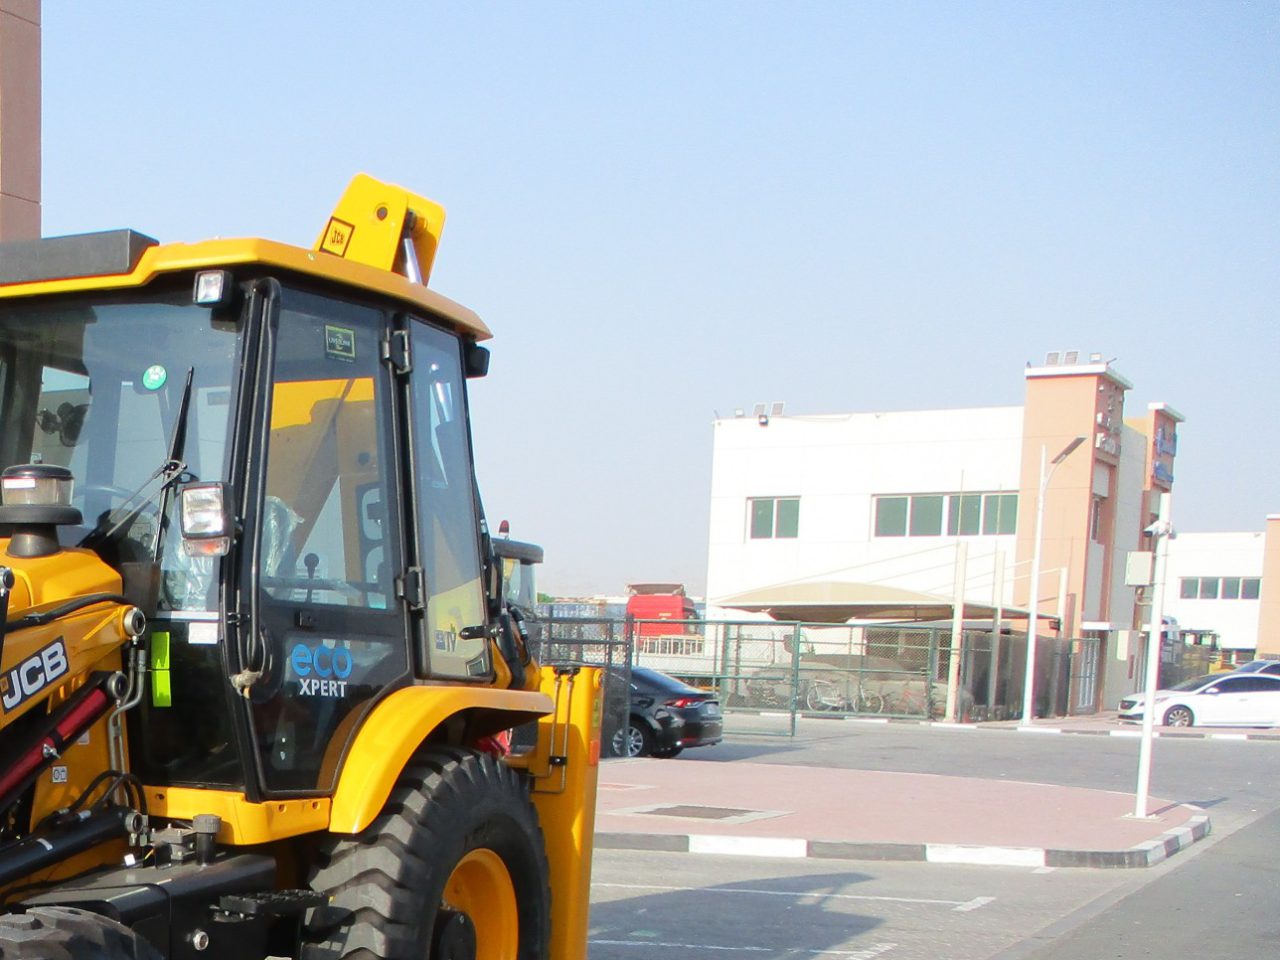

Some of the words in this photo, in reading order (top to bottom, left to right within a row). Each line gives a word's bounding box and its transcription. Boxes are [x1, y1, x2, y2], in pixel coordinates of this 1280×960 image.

[2, 642, 68, 709] JCB
[292, 643, 352, 679] eco
[299, 678, 348, 697] XPERT
